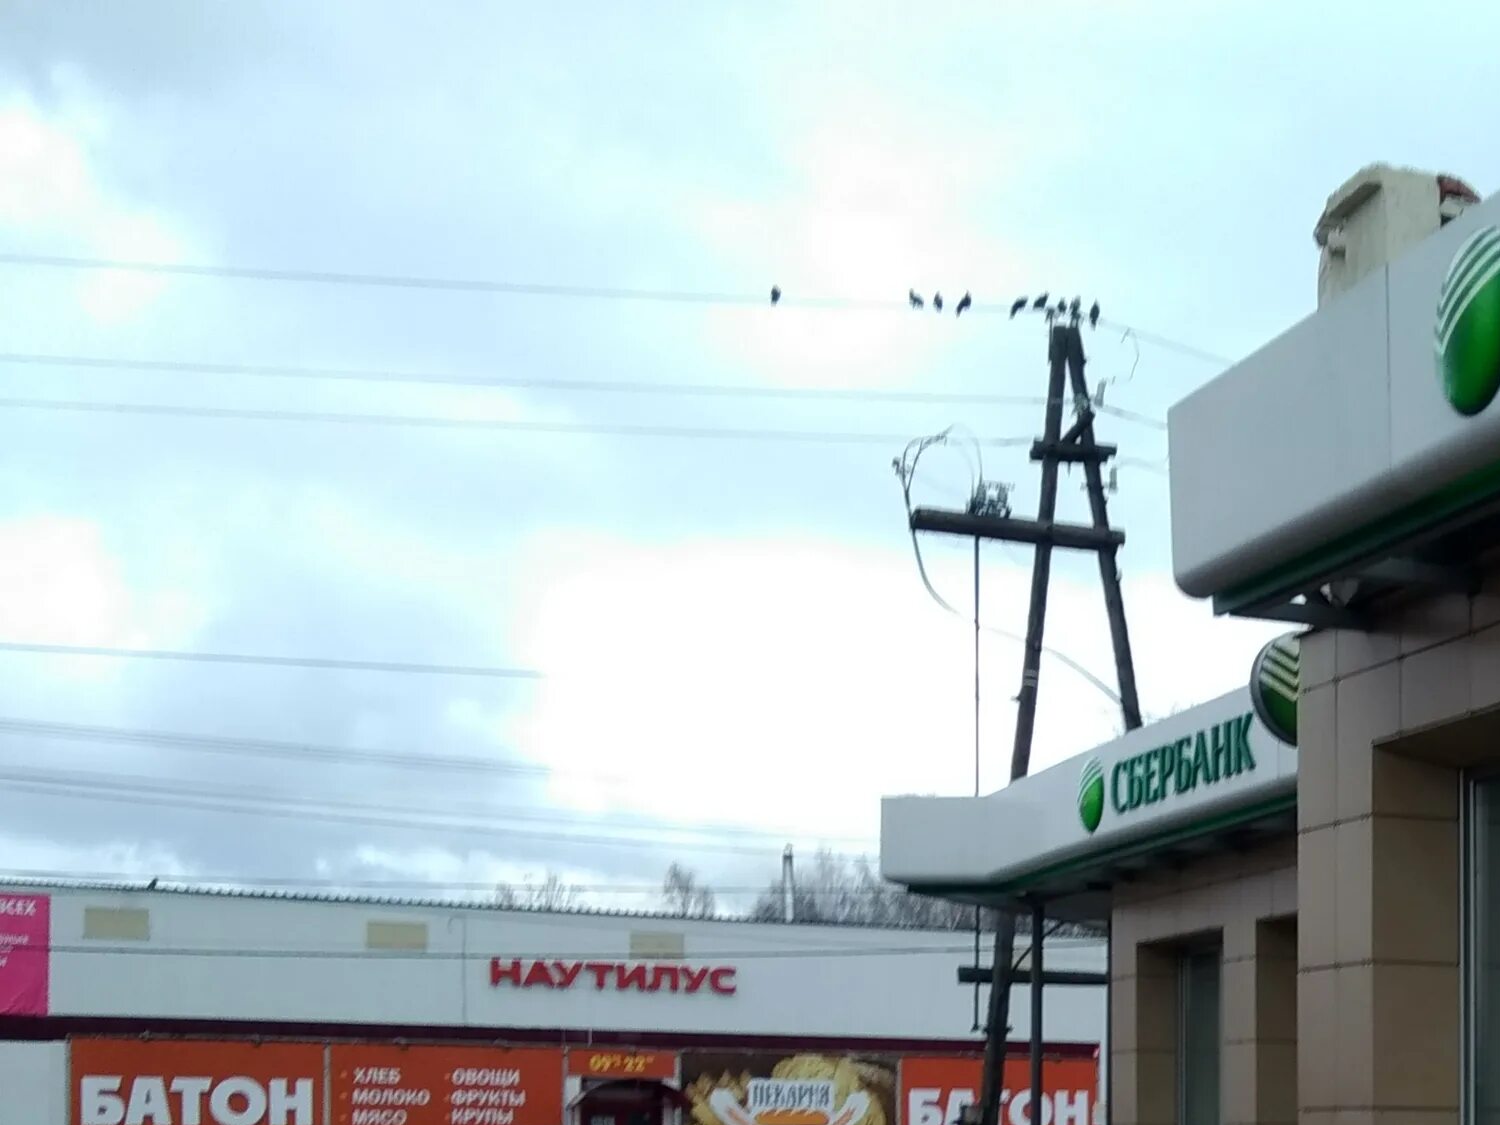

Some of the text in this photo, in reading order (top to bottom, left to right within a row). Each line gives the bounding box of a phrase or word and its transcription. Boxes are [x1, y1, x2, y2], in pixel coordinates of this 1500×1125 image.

[1111, 711, 1257, 815] СБЕРБАНК
[490, 957, 736, 994] НАУТИЛУС
[353, 1067, 401, 1084] ХЛЕБ
[451, 1068, 520, 1087] ОВОЩИ
[351, 1088, 431, 1105] МОЛОКО
[451, 1089, 526, 1106] ФРУКТЫ
[451, 1108, 514, 1125] КРУПЫ
